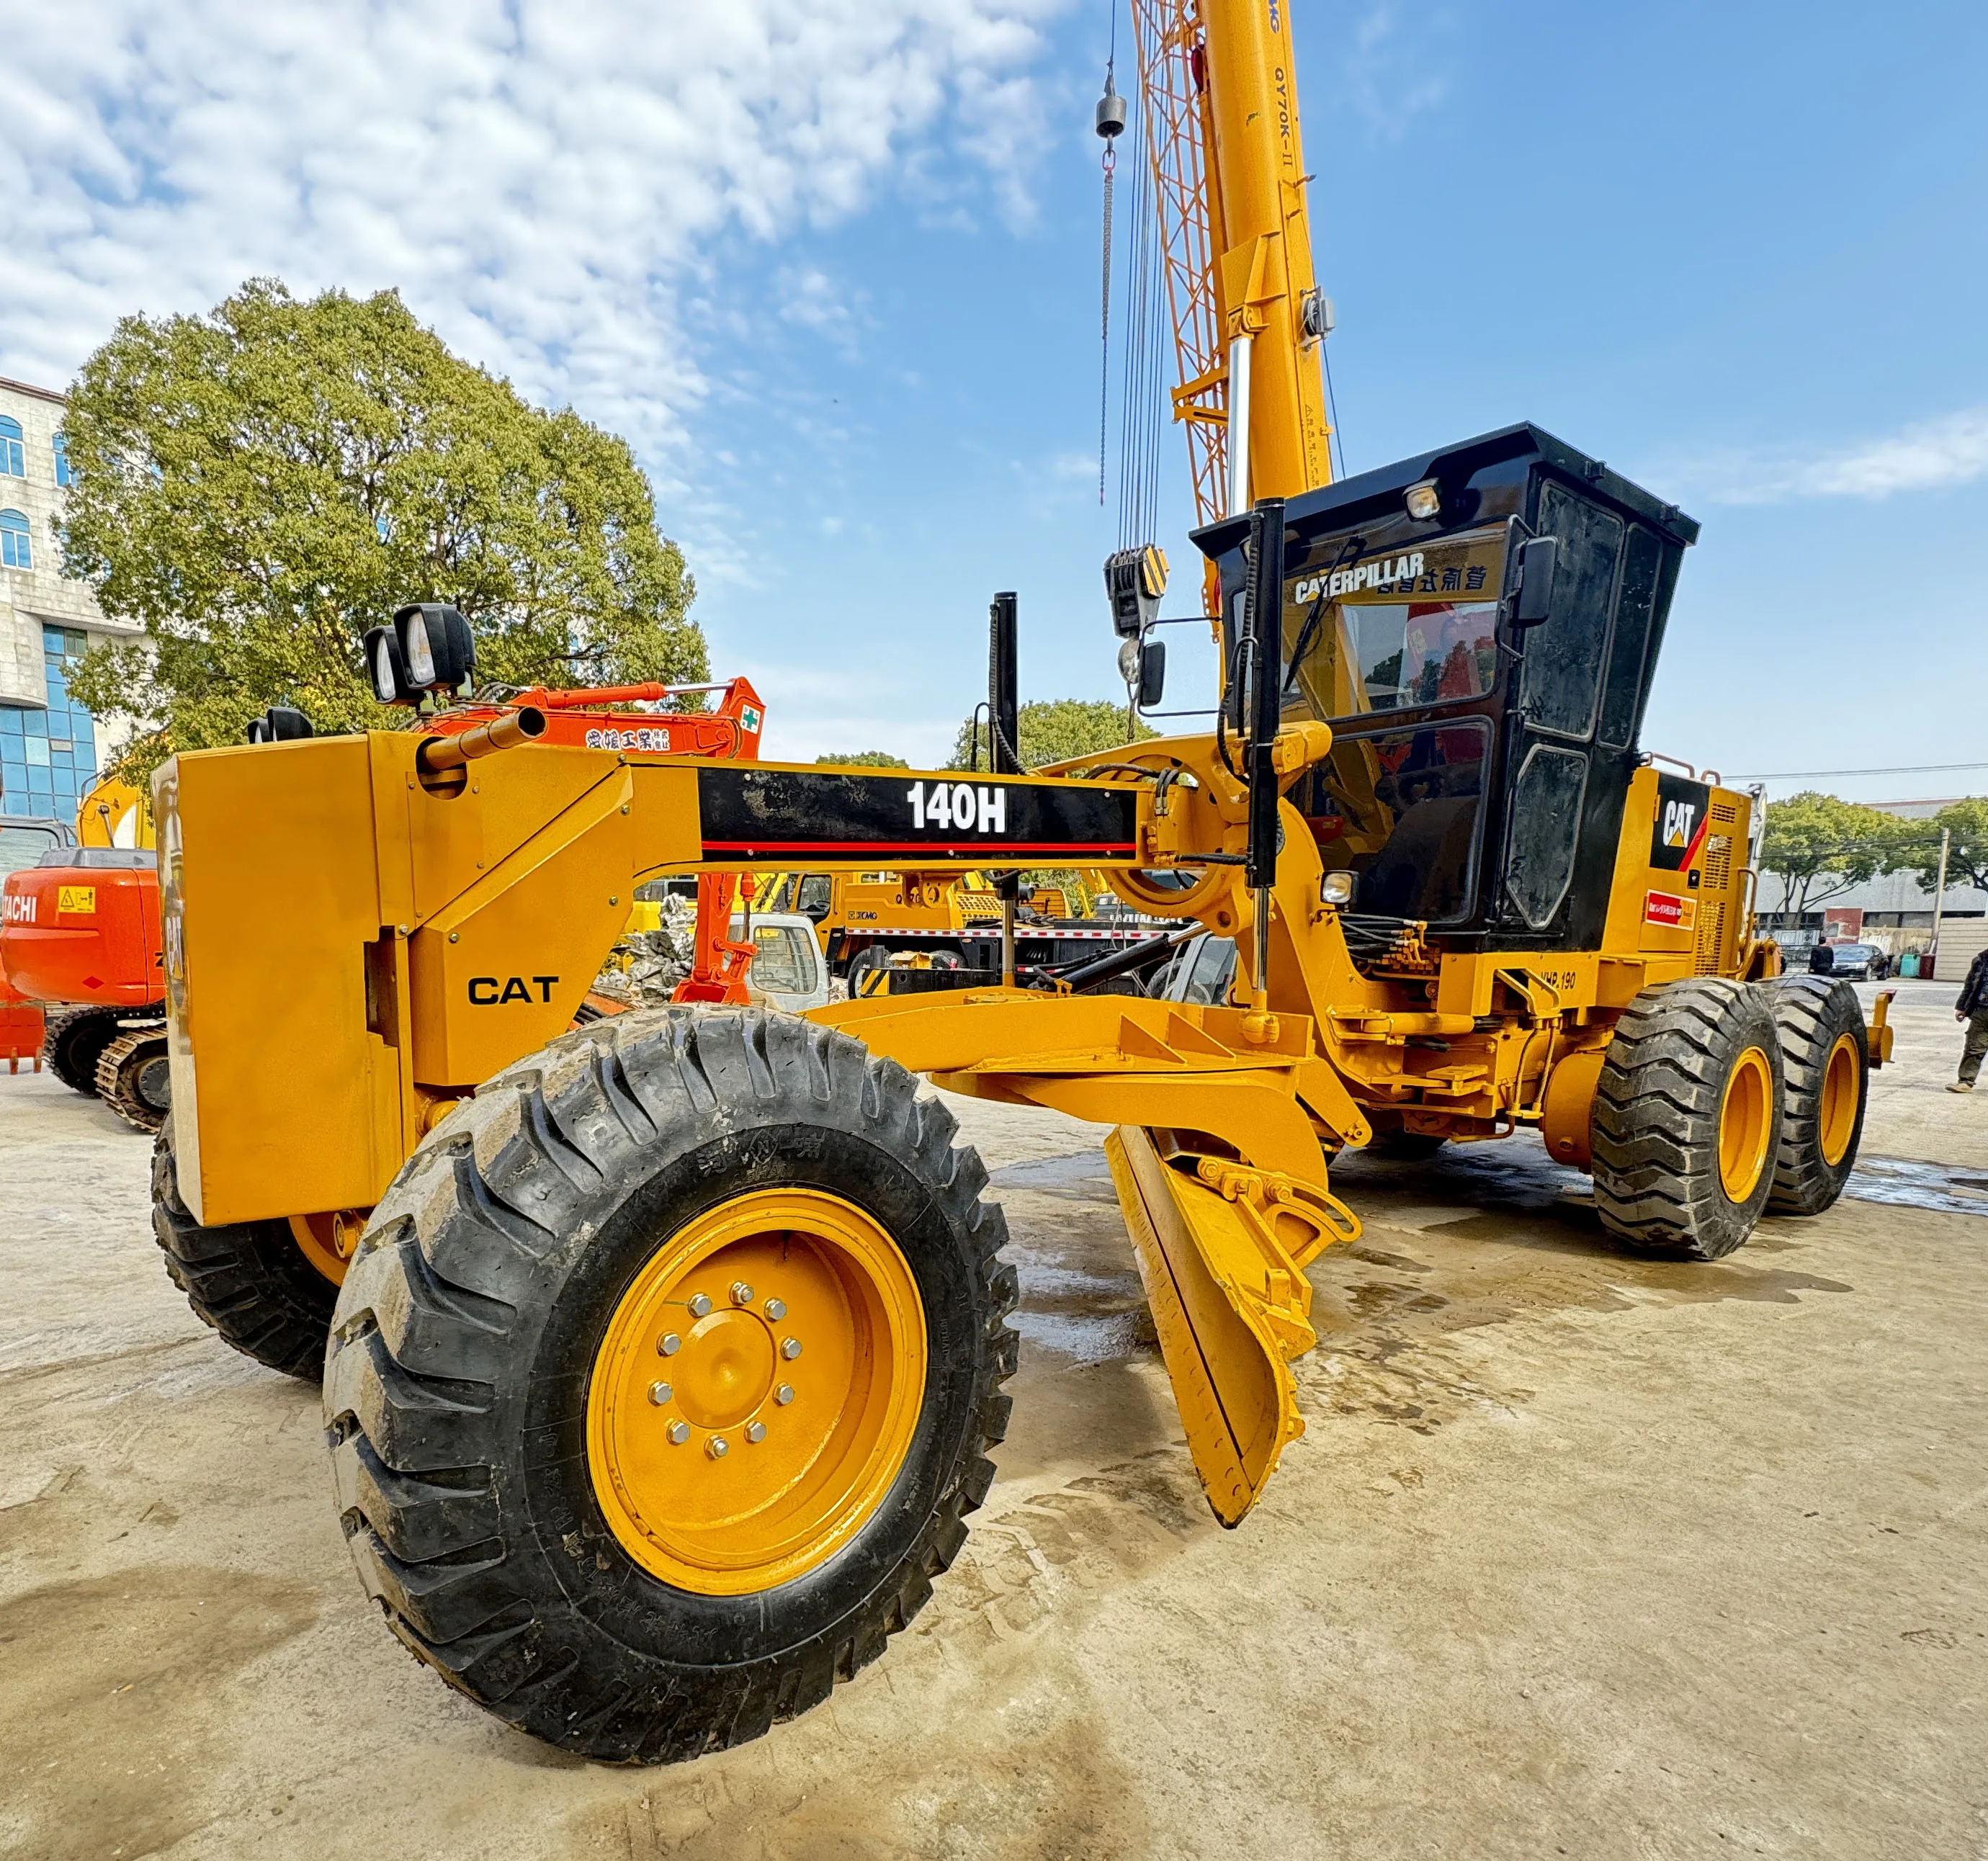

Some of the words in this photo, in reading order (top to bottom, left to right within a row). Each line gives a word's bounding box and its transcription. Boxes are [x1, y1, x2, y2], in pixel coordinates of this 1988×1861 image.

[1295, 552, 1424, 604] CATERPILLAR
[907, 781, 1006, 833] 140H
[1663, 800, 1695, 848] CAT
[468, 976, 560, 1005] CAT
